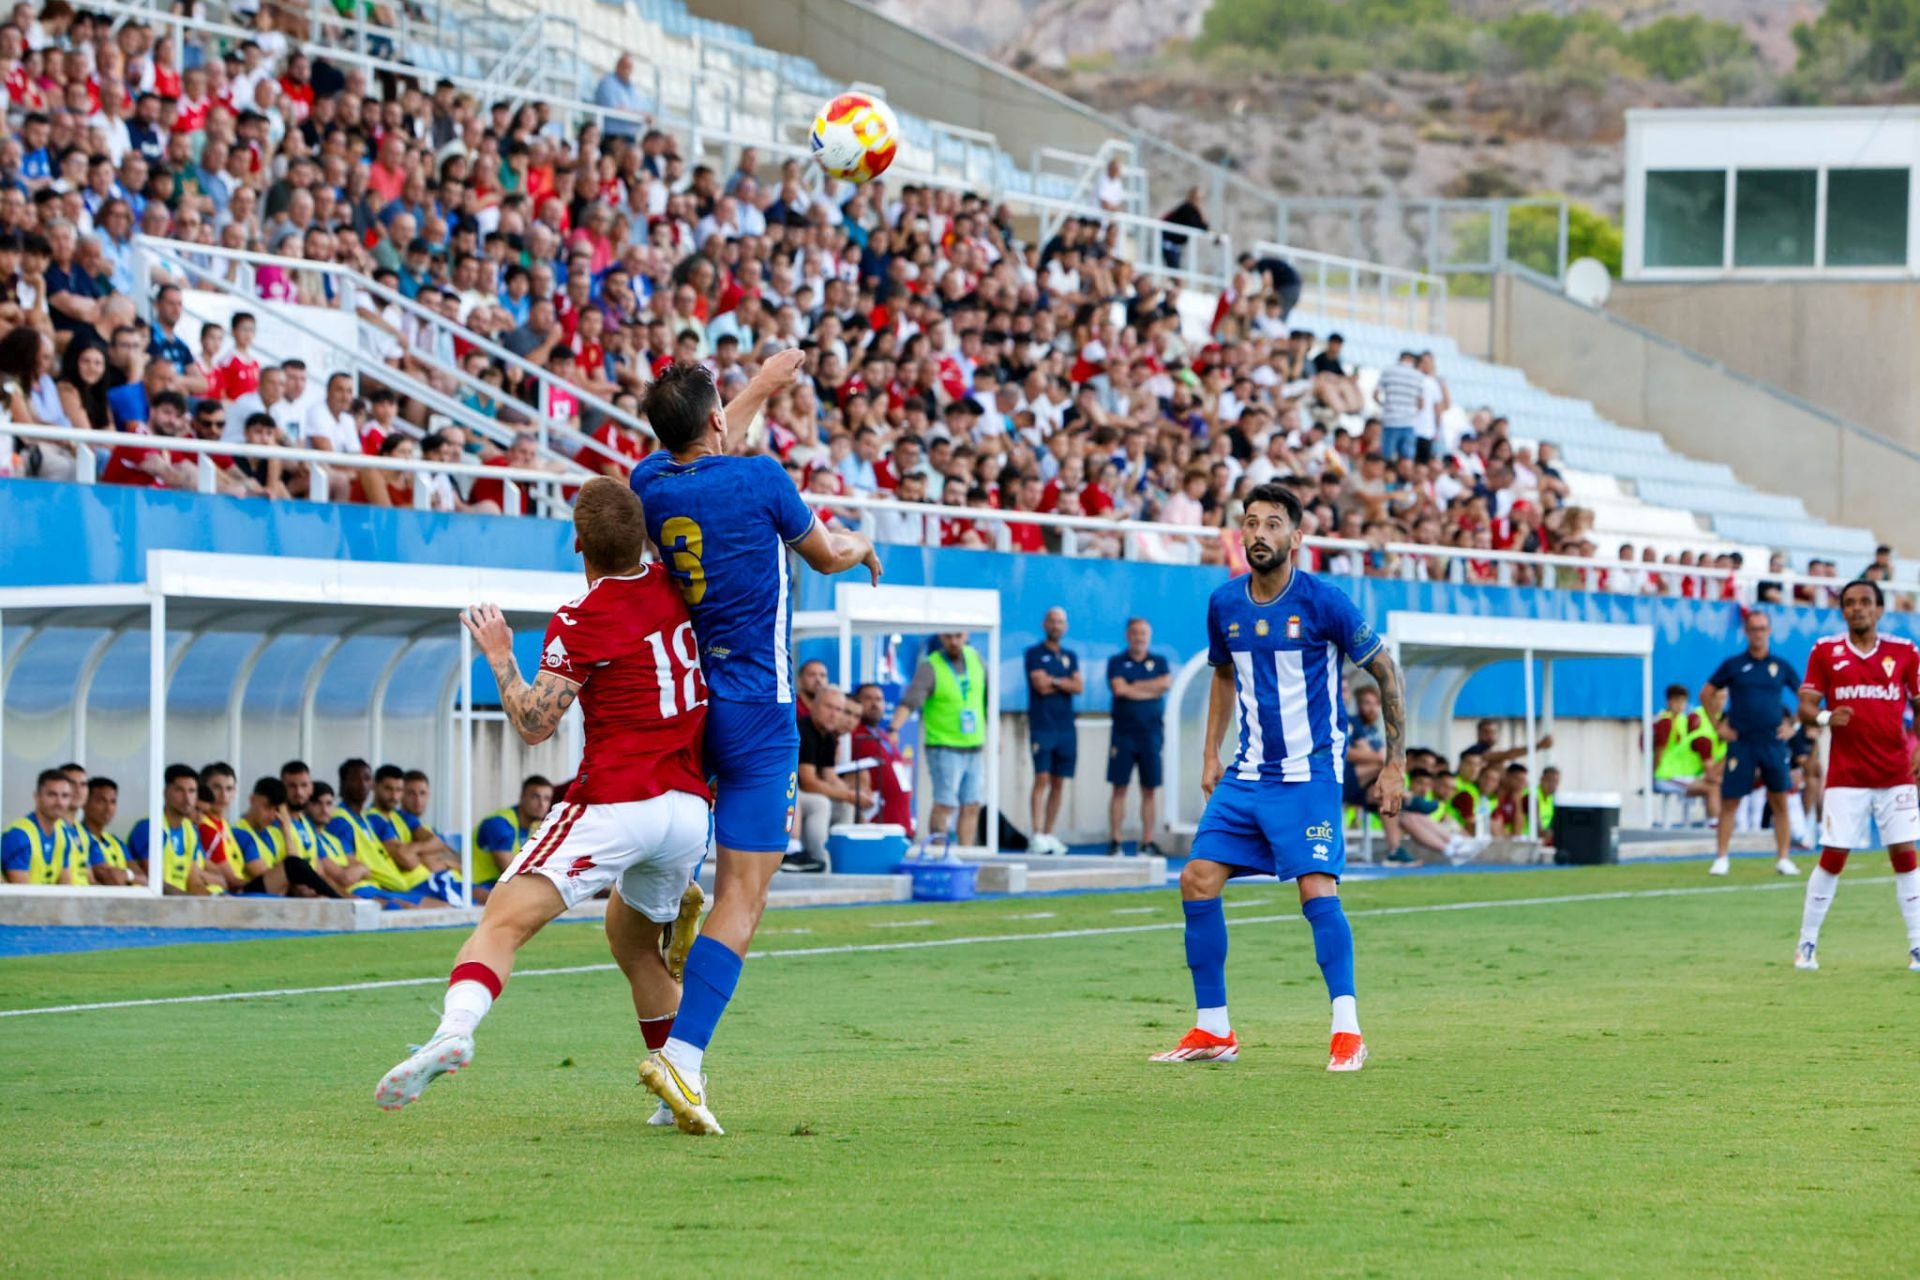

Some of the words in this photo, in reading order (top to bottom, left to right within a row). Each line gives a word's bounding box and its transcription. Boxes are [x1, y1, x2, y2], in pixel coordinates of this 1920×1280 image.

[660, 515, 708, 606] 3
[643, 620, 709, 719] 18
[786, 771, 797, 800] 3
